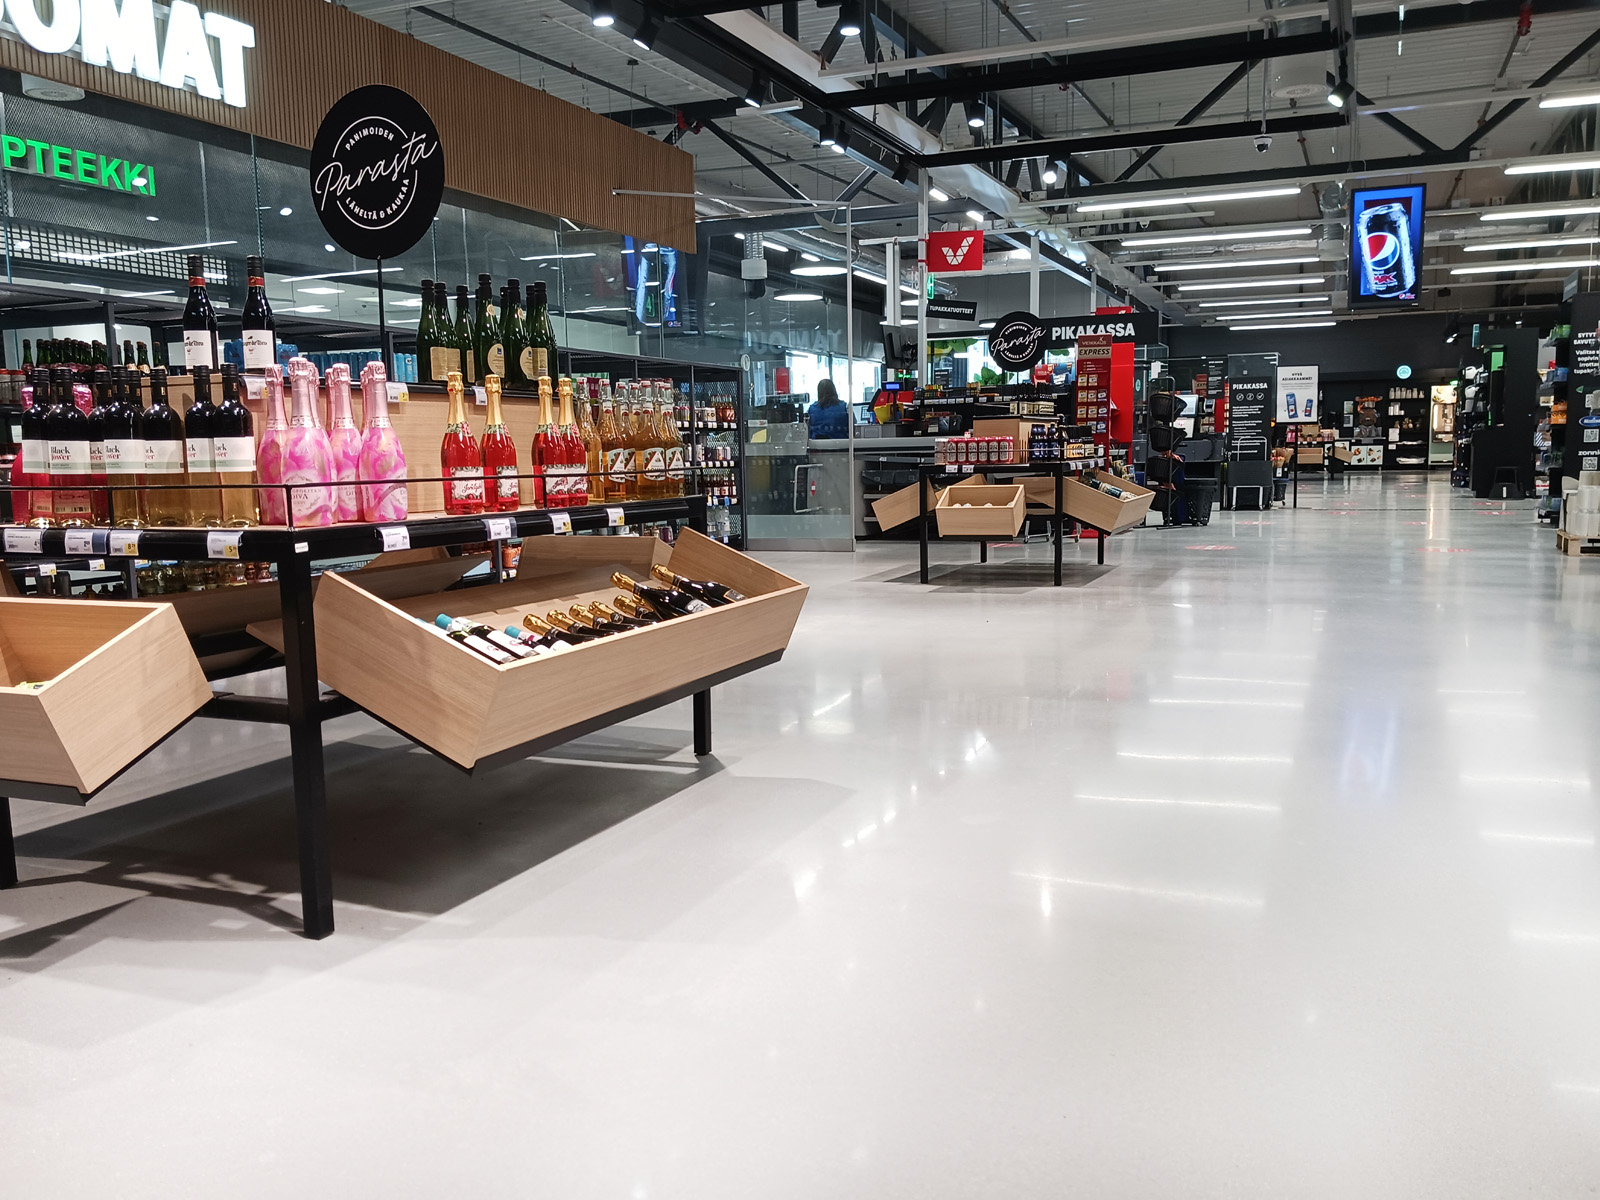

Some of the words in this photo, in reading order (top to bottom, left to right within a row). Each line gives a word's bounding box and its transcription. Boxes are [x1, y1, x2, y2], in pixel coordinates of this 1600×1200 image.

[0, 0, 255, 108] OMAT
[345, 127, 395, 150] PANIMOIDEN
[1, 133, 156, 197] PTEEKKI
[315, 131, 438, 211] Parasta
[345, 197, 378, 220] LÄHELTÄ
[387, 178, 410, 215] KAUKAA
[991, 326, 1047, 357] Parasta
[1052, 323, 1136, 340] PIKAKASSA
[1079, 348, 1111, 356] EXPRESS
[1232, 382, 1268, 391] PIKAKASSA
[106, 445, 120, 454] lack
